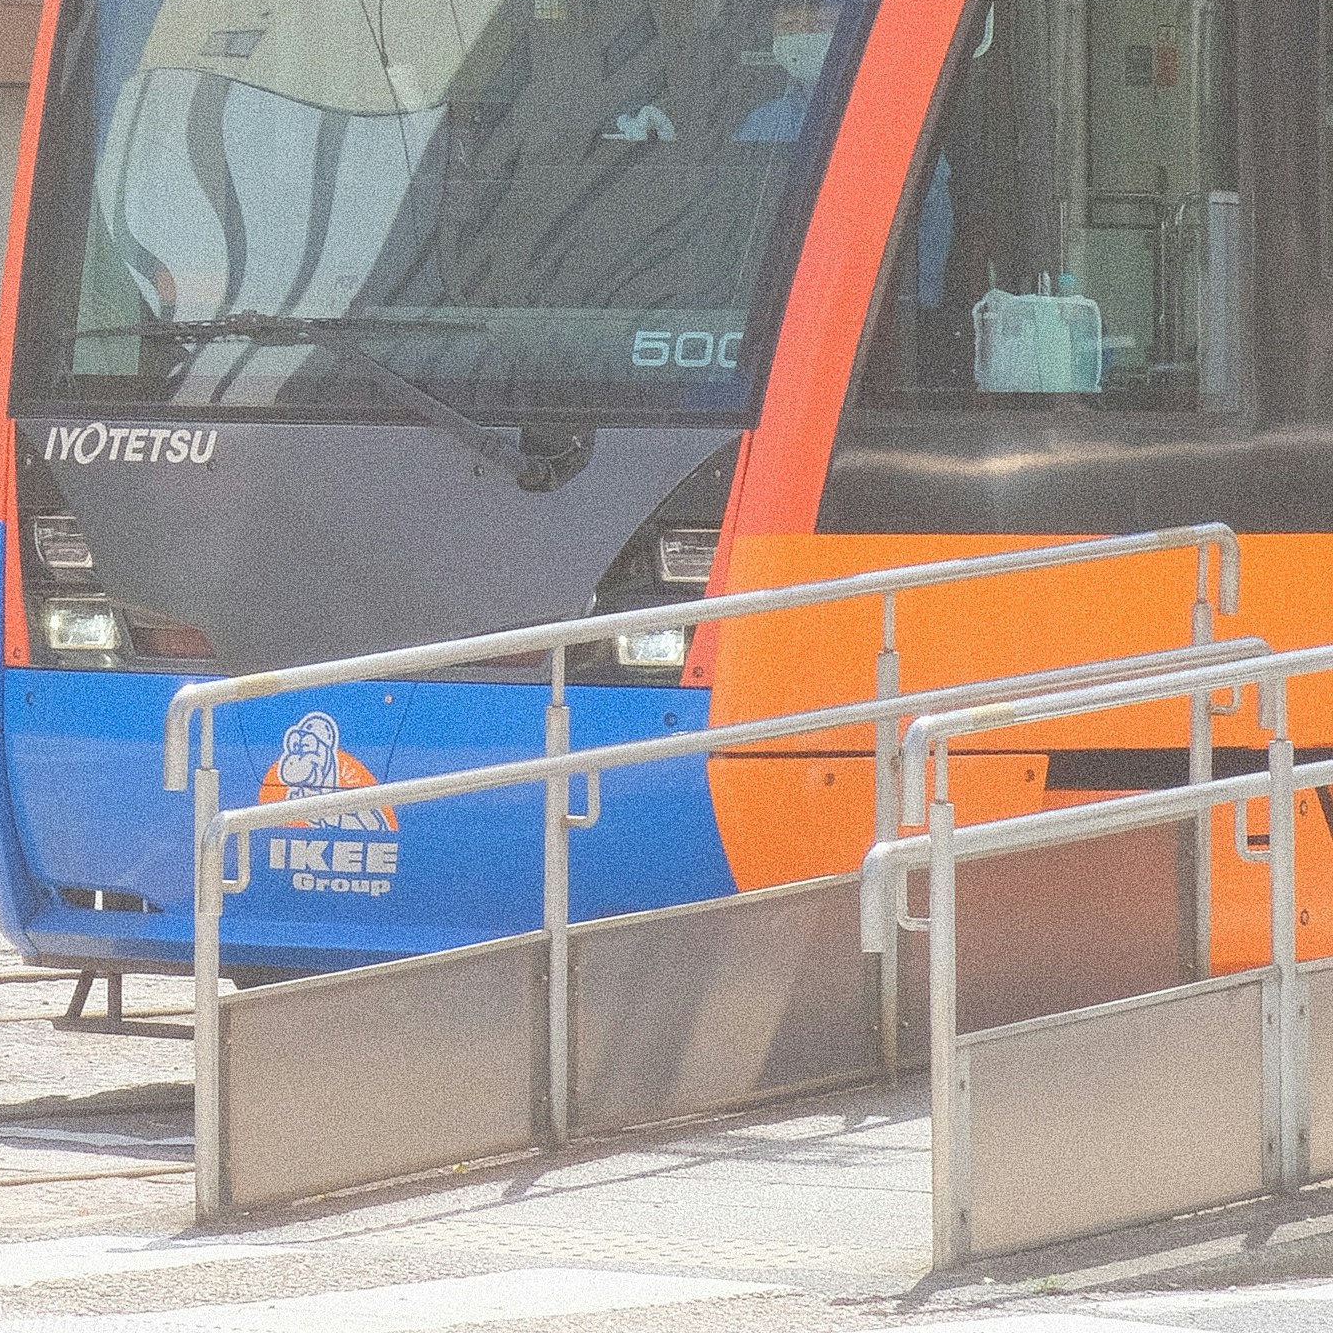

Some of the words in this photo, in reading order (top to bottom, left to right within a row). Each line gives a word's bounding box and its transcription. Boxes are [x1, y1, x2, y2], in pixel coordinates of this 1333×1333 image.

[44, 421, 218, 465] IYOTETSU
[268, 837, 400, 874] IKEE
[292, 873, 391, 898] Group
